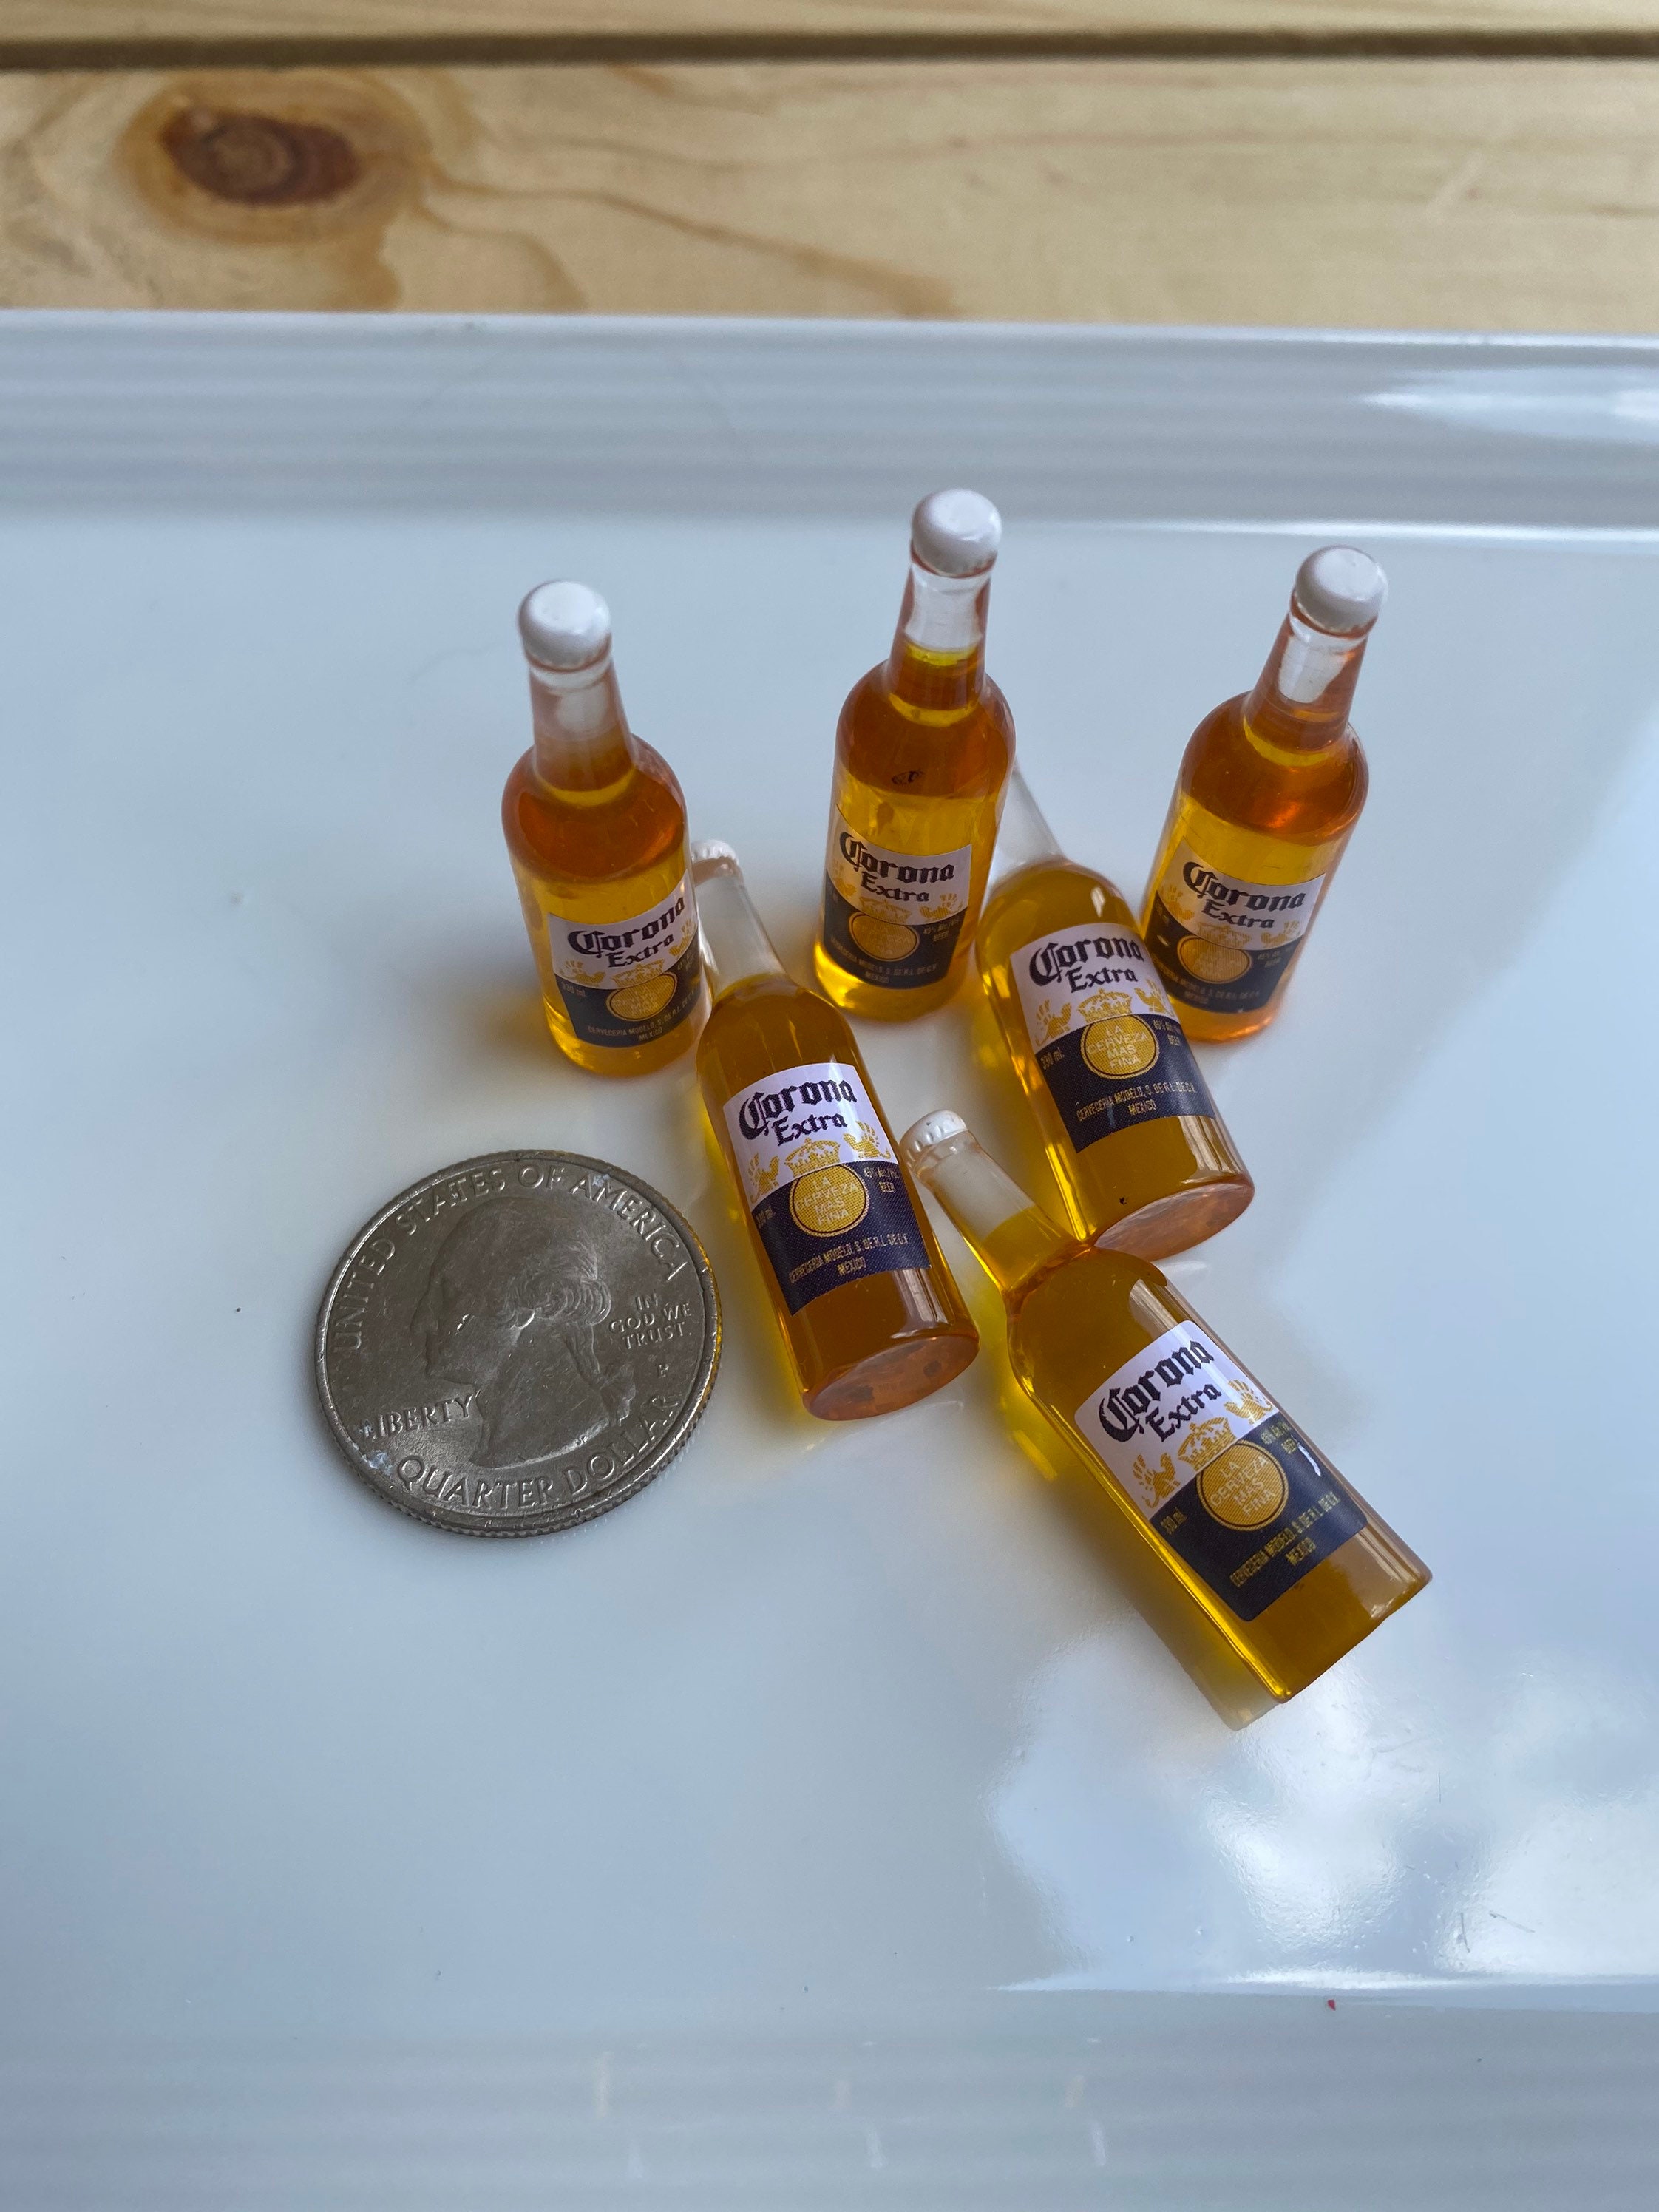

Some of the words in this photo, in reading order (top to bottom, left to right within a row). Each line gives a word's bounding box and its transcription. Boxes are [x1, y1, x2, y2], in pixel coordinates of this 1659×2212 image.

[839, 832, 954, 884] Corona
[860, 871, 930, 902] Extra
[1183, 861, 1306, 912] Corona
[567, 897, 685, 958] Corona
[1201, 899, 1275, 929] Extra
[605, 934, 674, 968] Extra
[1029, 937, 1145, 987] Corona
[1065, 966, 1139, 993] Extra
[1087, 1032, 1148, 1054] CERVEZA
[1105, 1025, 1123, 1036] LA
[1107, 1045, 1136, 1059] MAS
[1110, 1055, 1141, 1069] FINA
[739, 1079, 857, 1140] Corona
[771, 1113, 848, 1147] Extra
[813, 1176, 831, 1190] LA
[333, 1238, 396, 1353] UNITED
[395, 1168, 506, 1235] STATES
[518, 1164, 566, 1190] OF
[569, 1173, 688, 1281] AMERICA
[636, 1292, 659, 1310] IN
[609, 1312, 655, 1333] GOD
[663, 1302, 691, 1321] WE
[1099, 1340, 1215, 1442] Corona
[1146, 1383, 1222, 1442] Extra
[398, 1454, 558, 1510] QUARTER
[562, 1396, 679, 1496] DOLLAR
[1211, 1456, 1269, 1506] CERVEZA
[1219, 1462, 1240, 1479] LA
[1233, 1481, 1263, 1506] MAS
